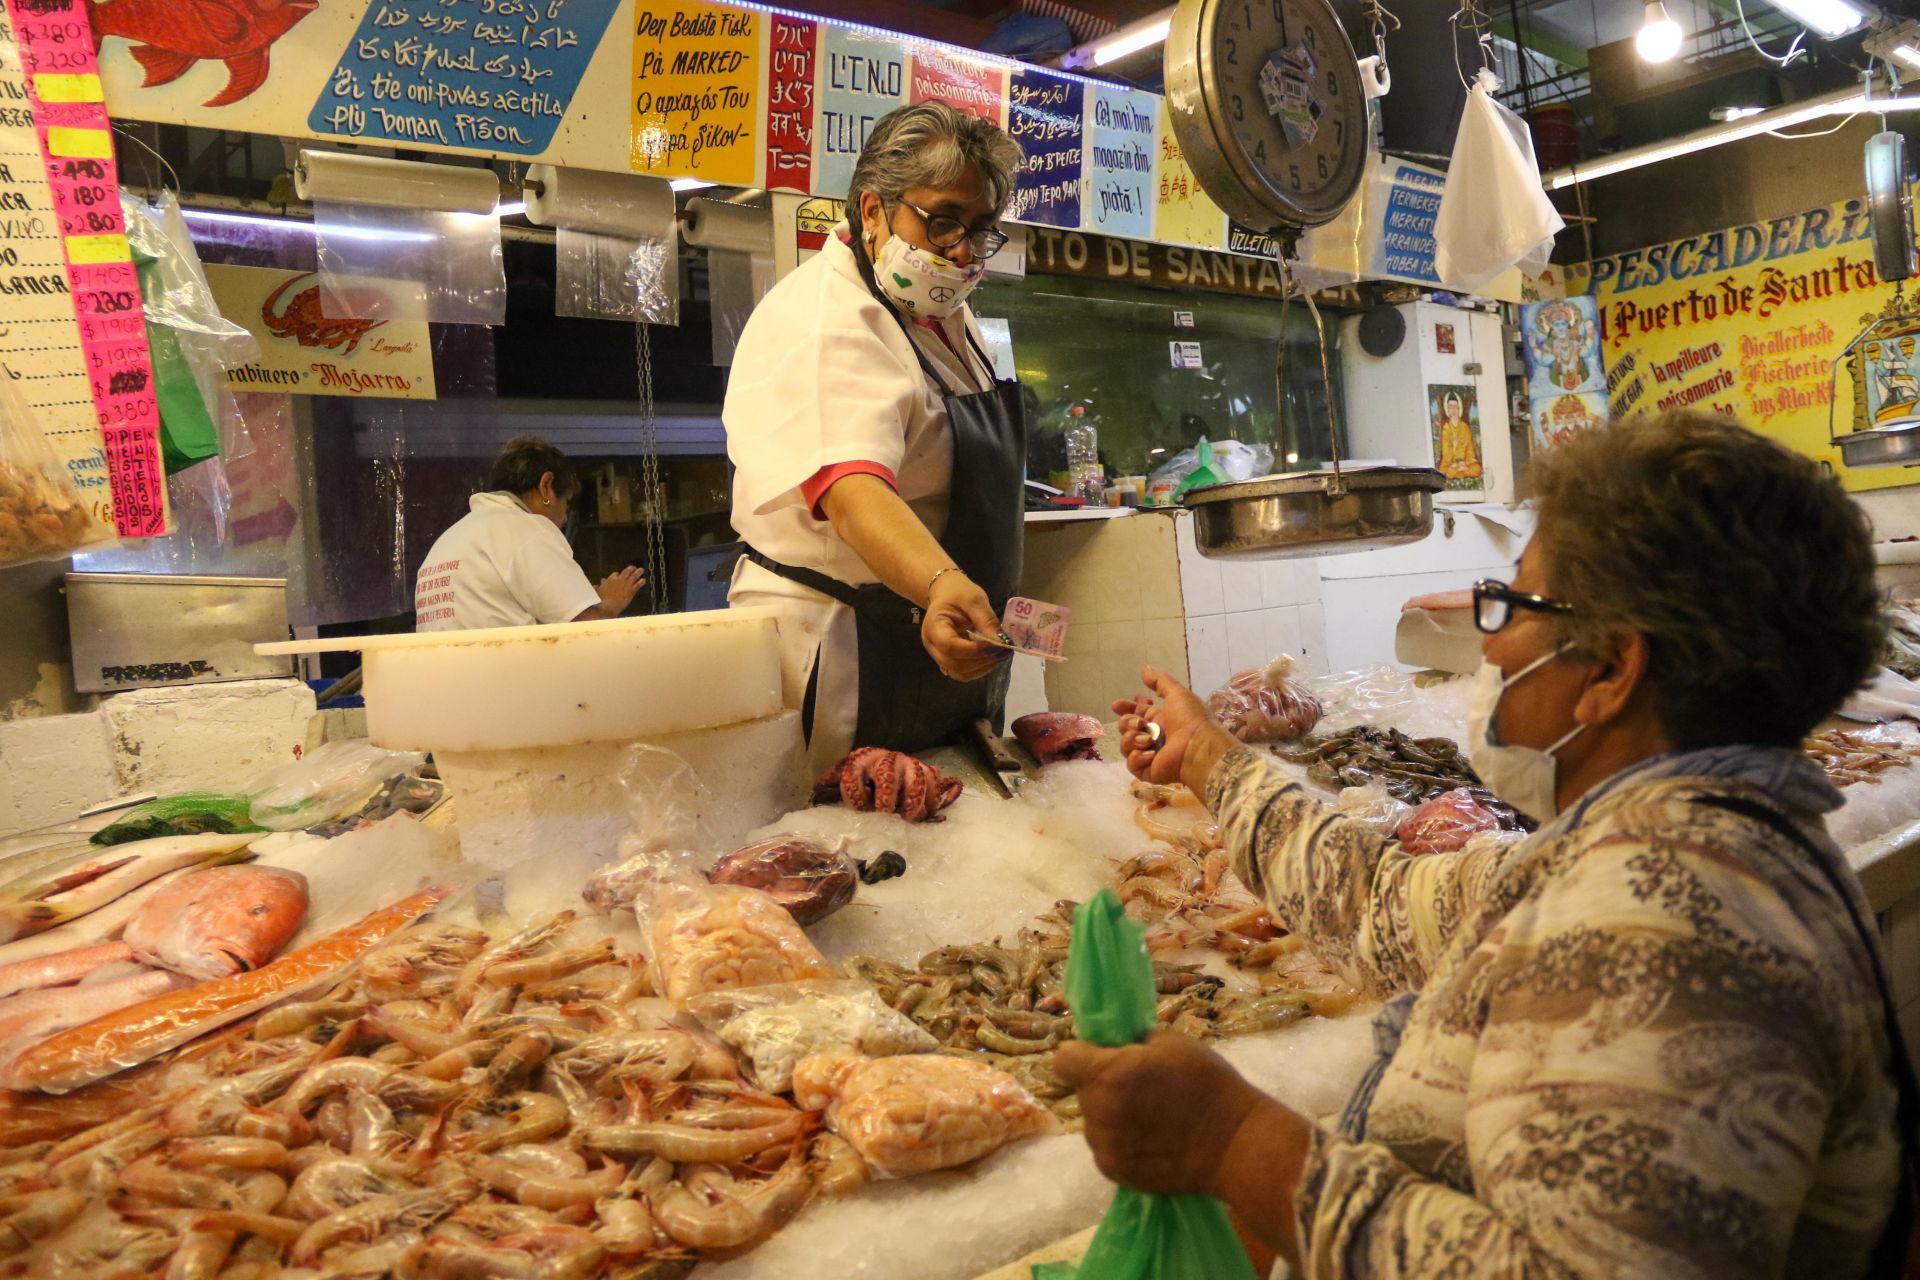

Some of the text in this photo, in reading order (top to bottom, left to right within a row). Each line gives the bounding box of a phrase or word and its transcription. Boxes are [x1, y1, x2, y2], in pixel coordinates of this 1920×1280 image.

[1026, 226, 1088, 272] RTO
[1106, 237, 1151, 277] DE
[1586, 199, 1873, 297] PESCADERi
[1614, 289, 1719, 348] Puerto
[1715, 276, 1755, 316] de
[1758, 256, 1878, 318] Santa
[227, 363, 411, 393] rabinero Mojarra
[1015, 600, 1033, 616] 50
